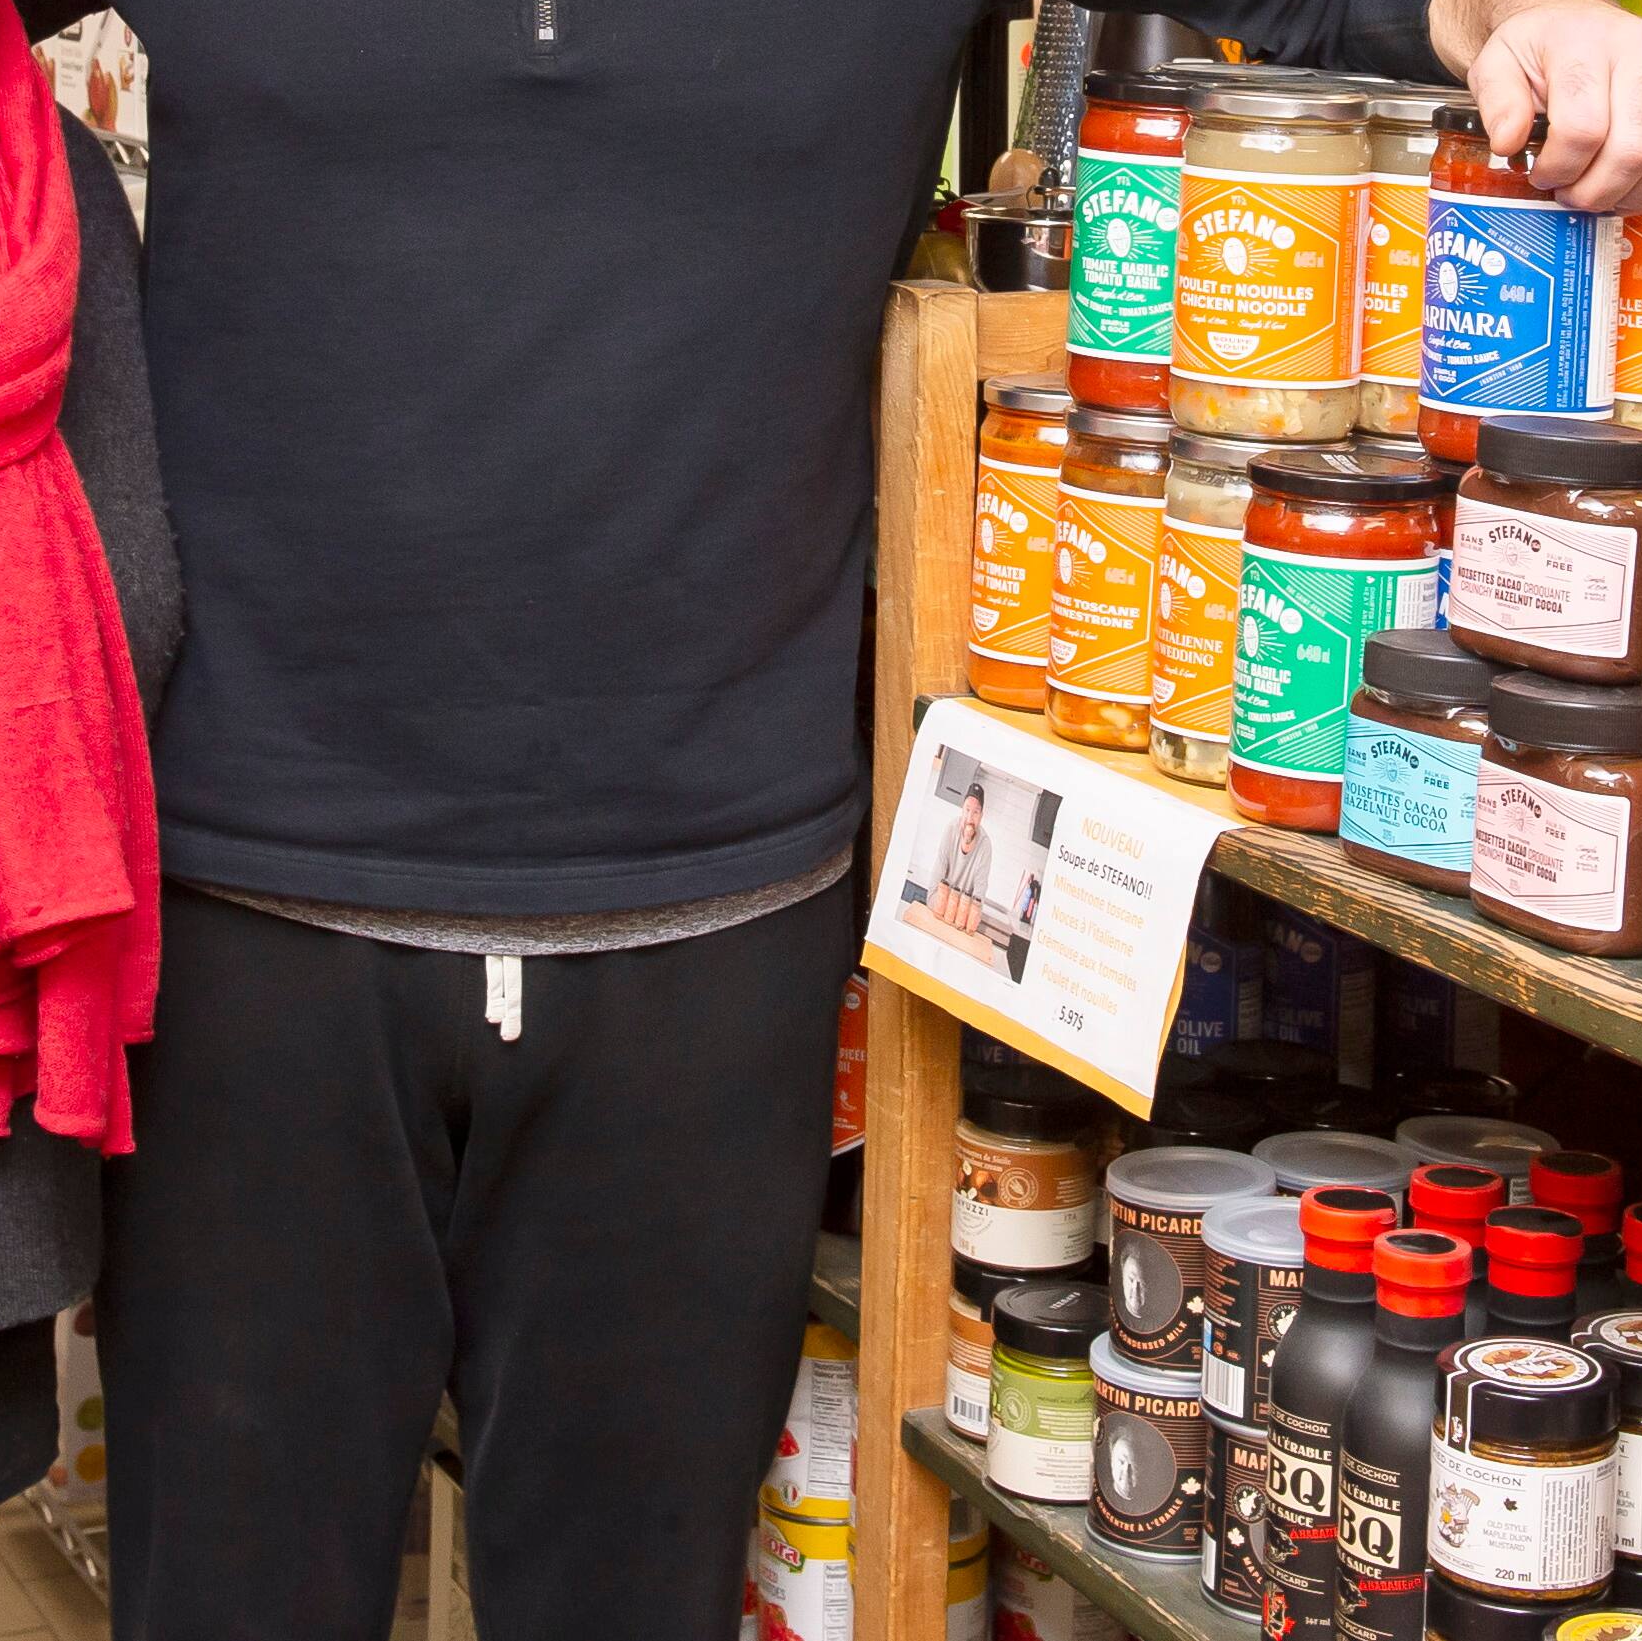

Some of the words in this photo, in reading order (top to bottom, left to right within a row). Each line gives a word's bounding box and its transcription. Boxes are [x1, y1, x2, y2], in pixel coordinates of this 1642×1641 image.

[1082, 256, 1117, 274] TOMATE
[1121, 261, 1169, 278] BASILIC
[1084, 271, 1123, 289] TOMATO
[1126, 274, 1161, 291] BASIL
[1235, 282, 1314, 301] NOUILLES
[1180, 291, 1235, 311] CHICKEN
[1236, 298, 1307, 317] NOODLE
[1546, 559, 1573, 572] FREE
[1457, 566, 1495, 585] NOISETTES
[1496, 575, 1522, 592] CACAO
[1523, 582, 1571, 603] CROQUANTE
[1074, 598, 1140, 620] TOSCANE
[1494, 588, 1533, 607] HAZELNUT
[1535, 599, 1563, 614] COCOA
[1423, 776, 1450, 790] FREE
[1345, 781, 1400, 808] NOISETTES
[1404, 799, 1448, 820] CACAO
[1344, 793, 1399, 821] HAZELNUT
[1403, 813, 1447, 834] COCOA
[1082, 817, 1144, 860] NOUVEAU
[1058, 844, 1086, 871] Soupe
[1088, 858, 1099, 876] de
[1101, 864, 1153, 901] STEFANO!!
[1059, 1005, 1085, 1033] 5.97$
[1177, 1018, 1224, 1038] OLIVE
[1176, 1037, 1201, 1055] OIL
[1141, 1211, 1204, 1236] PICARD
[1134, 1395, 1201, 1418] PICARD
[1287, 1416, 1328, 1435] COCHON
[1448, 1459, 1461, 1473] DE
[1465, 1468, 1522, 1487] COCHON
[1277, 1510, 1314, 1529] SAUCE
[1496, 1567, 1514, 1582] 220
[1518, 1571, 1532, 1582] ml
